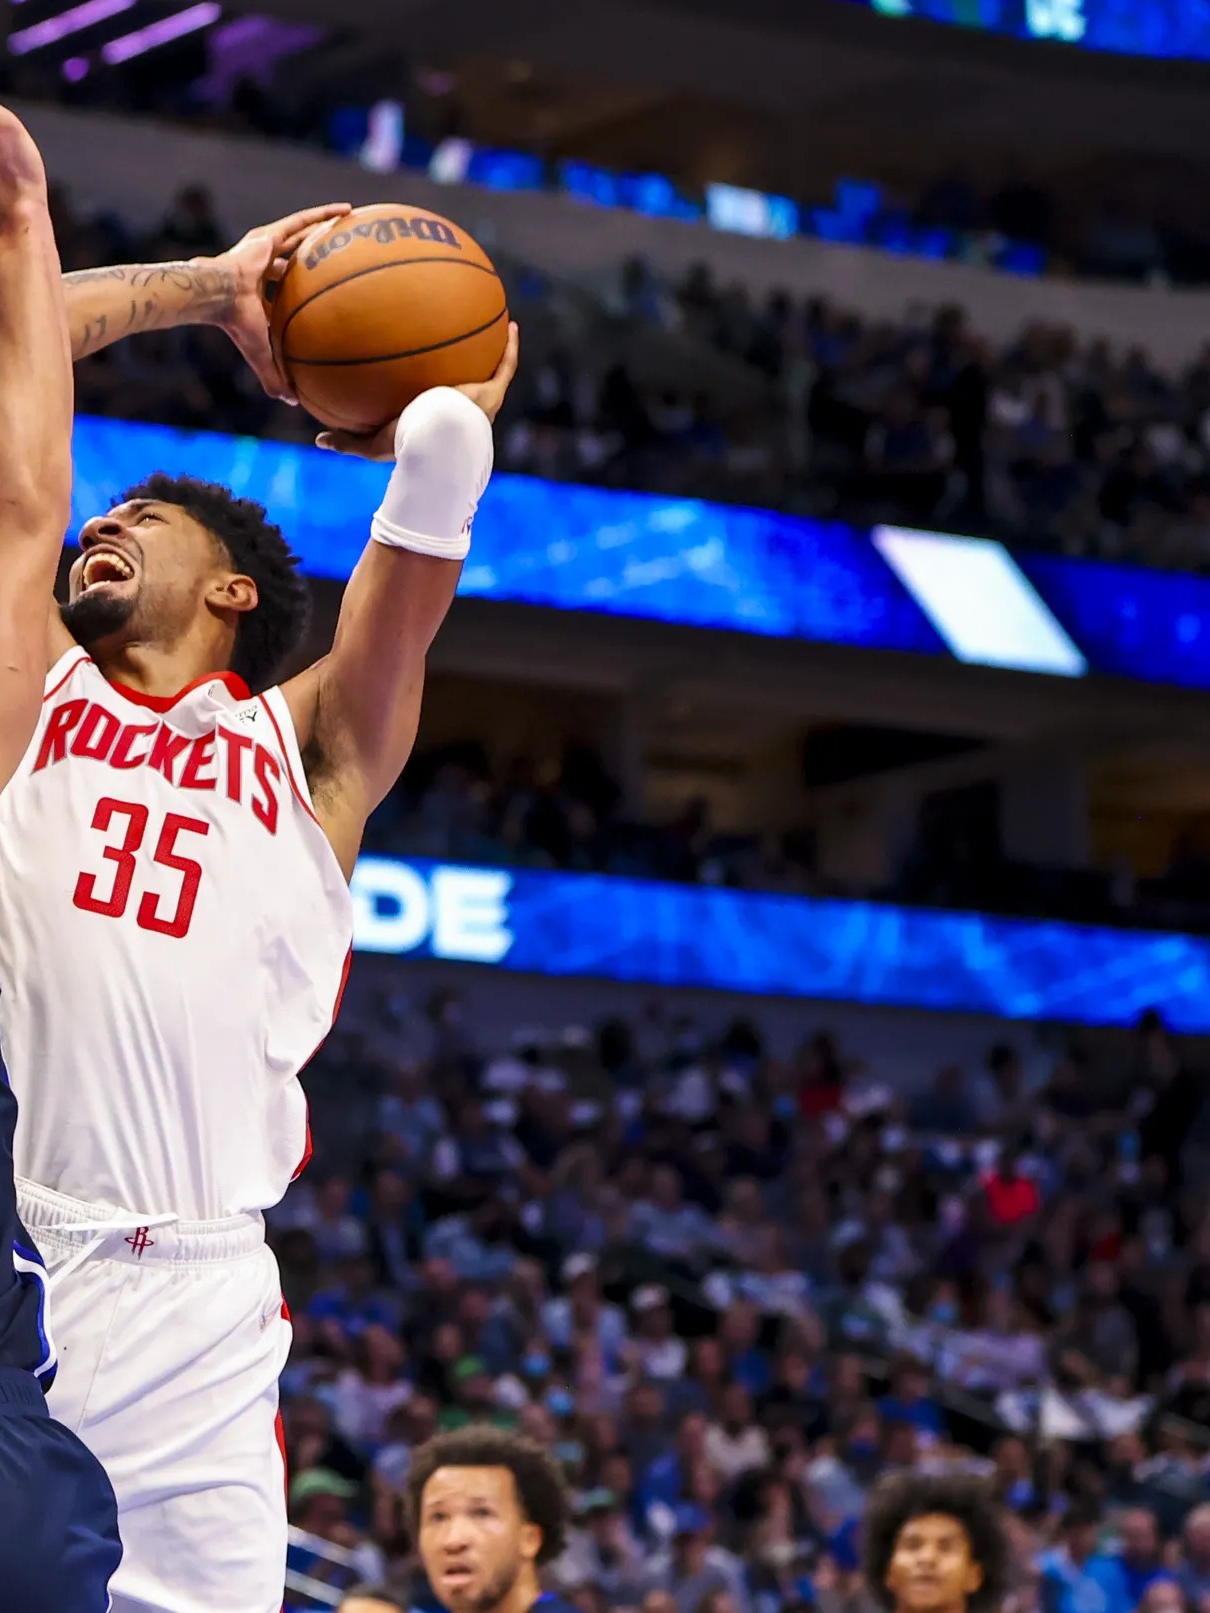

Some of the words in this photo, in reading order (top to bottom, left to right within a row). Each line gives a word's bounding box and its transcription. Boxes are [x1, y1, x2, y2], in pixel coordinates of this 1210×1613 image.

[304, 217, 462, 271] Wilson
[30, 698, 280, 837] ROCKETS
[73, 796, 210, 939] 35
[352, 857, 515, 964] DE
